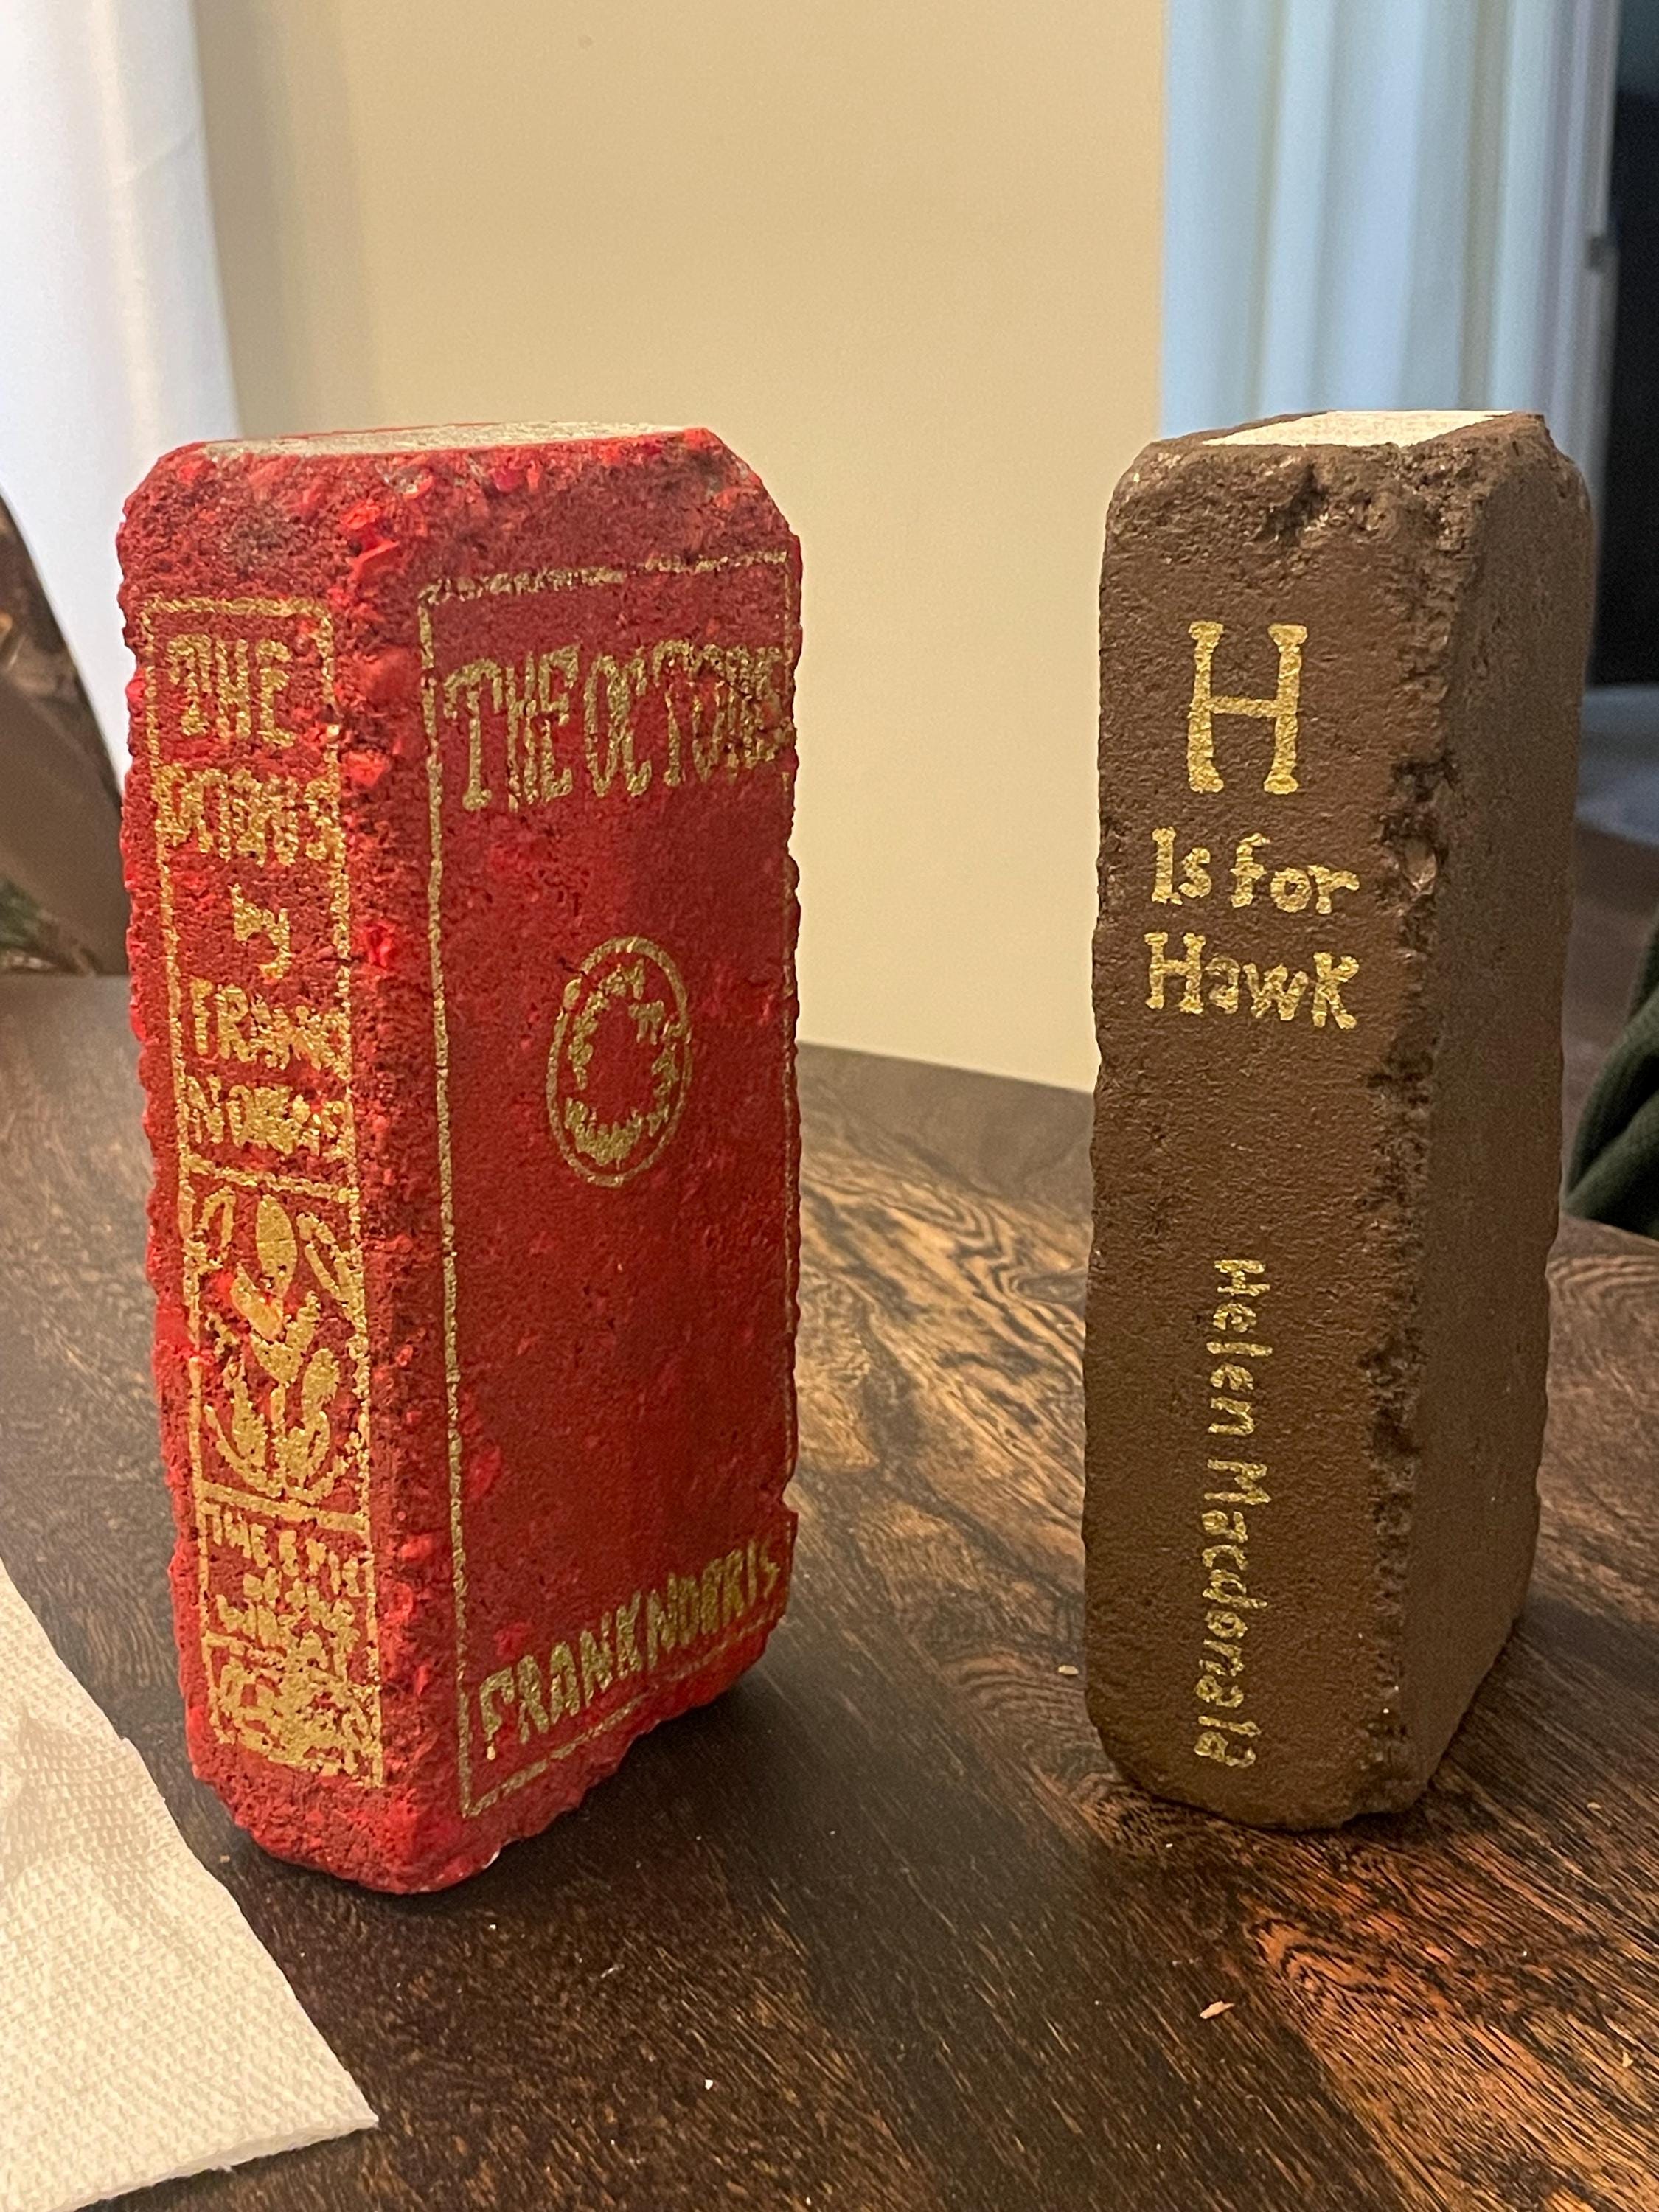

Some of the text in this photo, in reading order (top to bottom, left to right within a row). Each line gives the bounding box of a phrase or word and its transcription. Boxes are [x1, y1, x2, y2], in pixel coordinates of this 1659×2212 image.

[168, 633, 293, 748] THE
[442, 641, 581, 812] THE
[1188, 621, 1309, 794] H
[1151, 826, 1360, 915] Is for
[1206, 1259, 1273, 1436] Helen
[479, 1590, 644, 1761] FRANK
